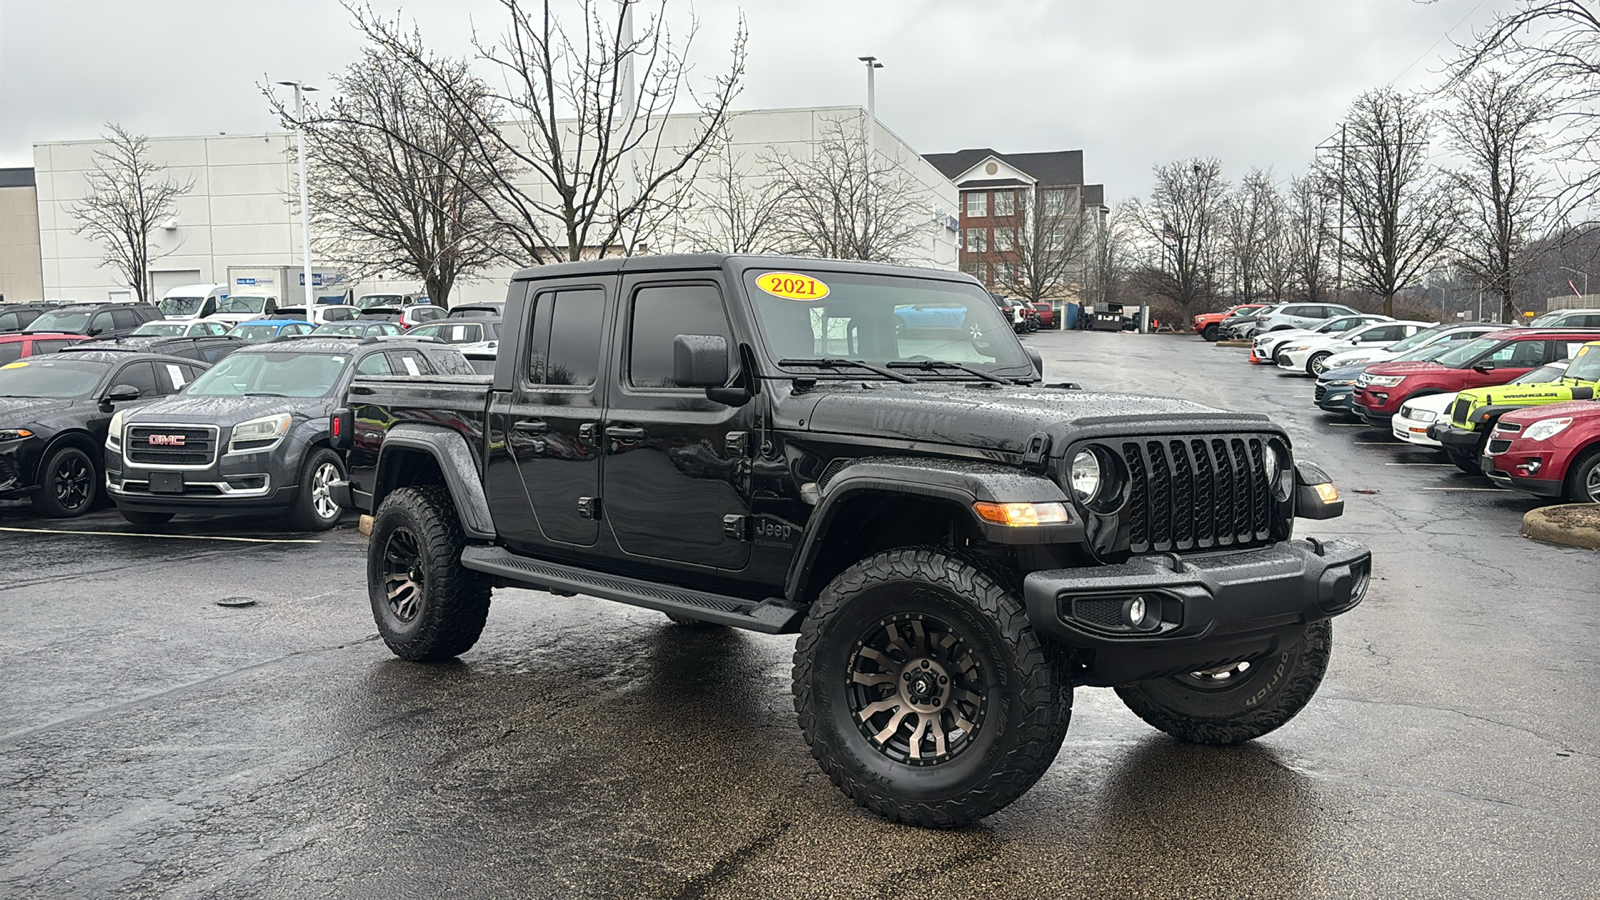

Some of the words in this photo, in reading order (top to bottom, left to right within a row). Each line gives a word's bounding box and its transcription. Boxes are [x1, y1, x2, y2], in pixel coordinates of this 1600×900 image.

[771, 277, 817, 295] 2021
[149, 434, 185, 446] GMC
[756, 519, 791, 540] Jeep
[754, 539, 793, 549] GLADIATOR
